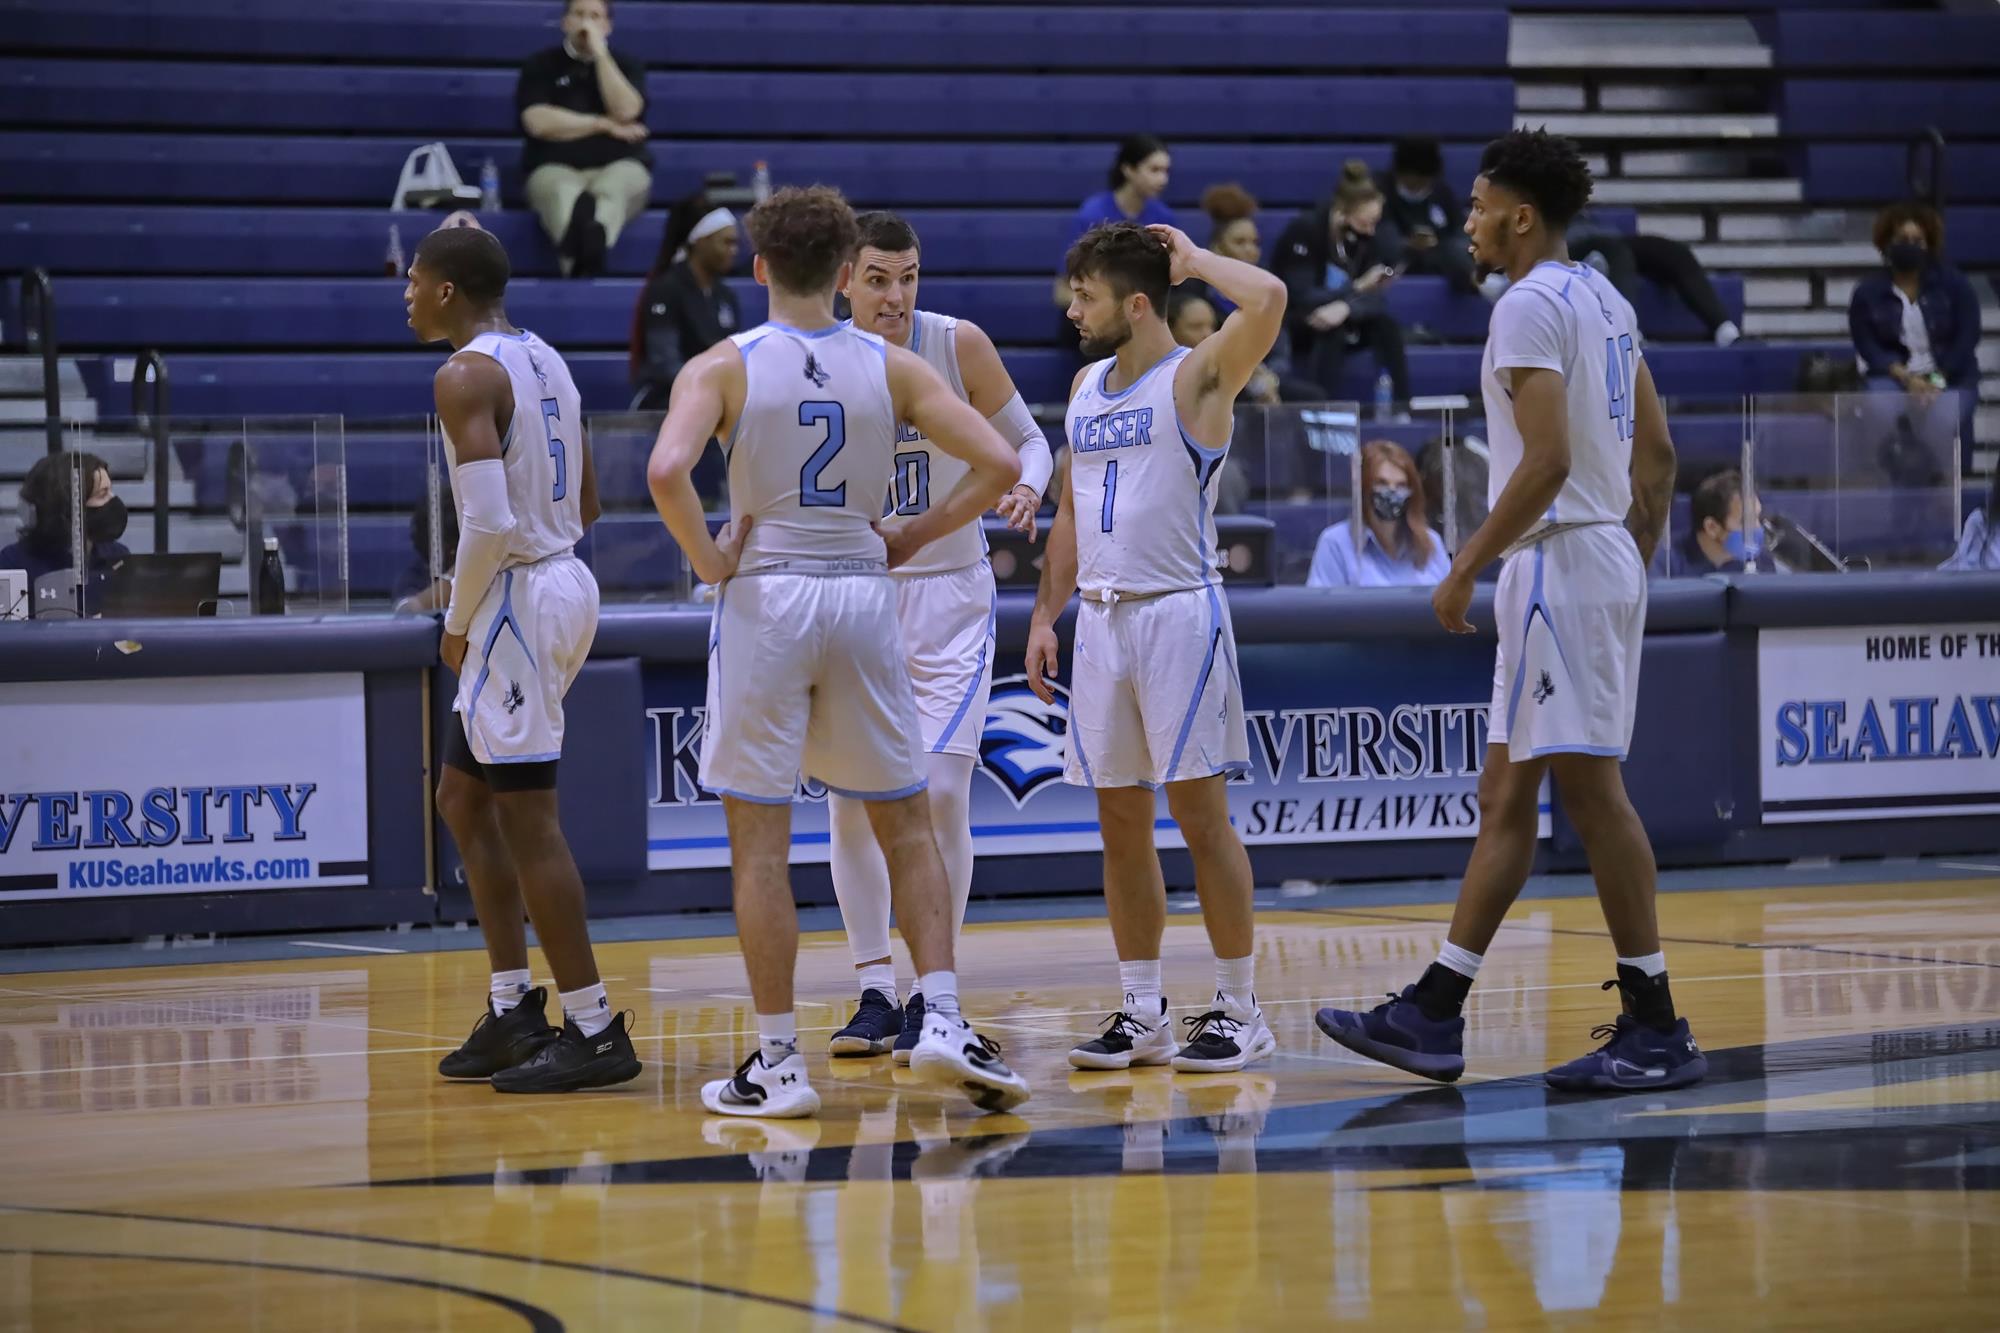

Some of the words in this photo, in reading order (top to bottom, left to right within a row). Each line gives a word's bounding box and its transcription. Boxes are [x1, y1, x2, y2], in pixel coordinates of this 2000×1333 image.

[540, 397, 567, 502] 5
[798, 400, 846, 507] 2
[1072, 407, 1153, 453] KEISER
[882, 450, 930, 518] 0
[1101, 460, 1118, 533] 1
[1866, 635, 1931, 661] HOME
[1940, 634, 1968, 659] OF
[1229, 702, 1492, 785] VERSIT
[1246, 791, 1478, 836] SEAHAWKS
[68, 856, 310, 889] KUSeahawks.com
